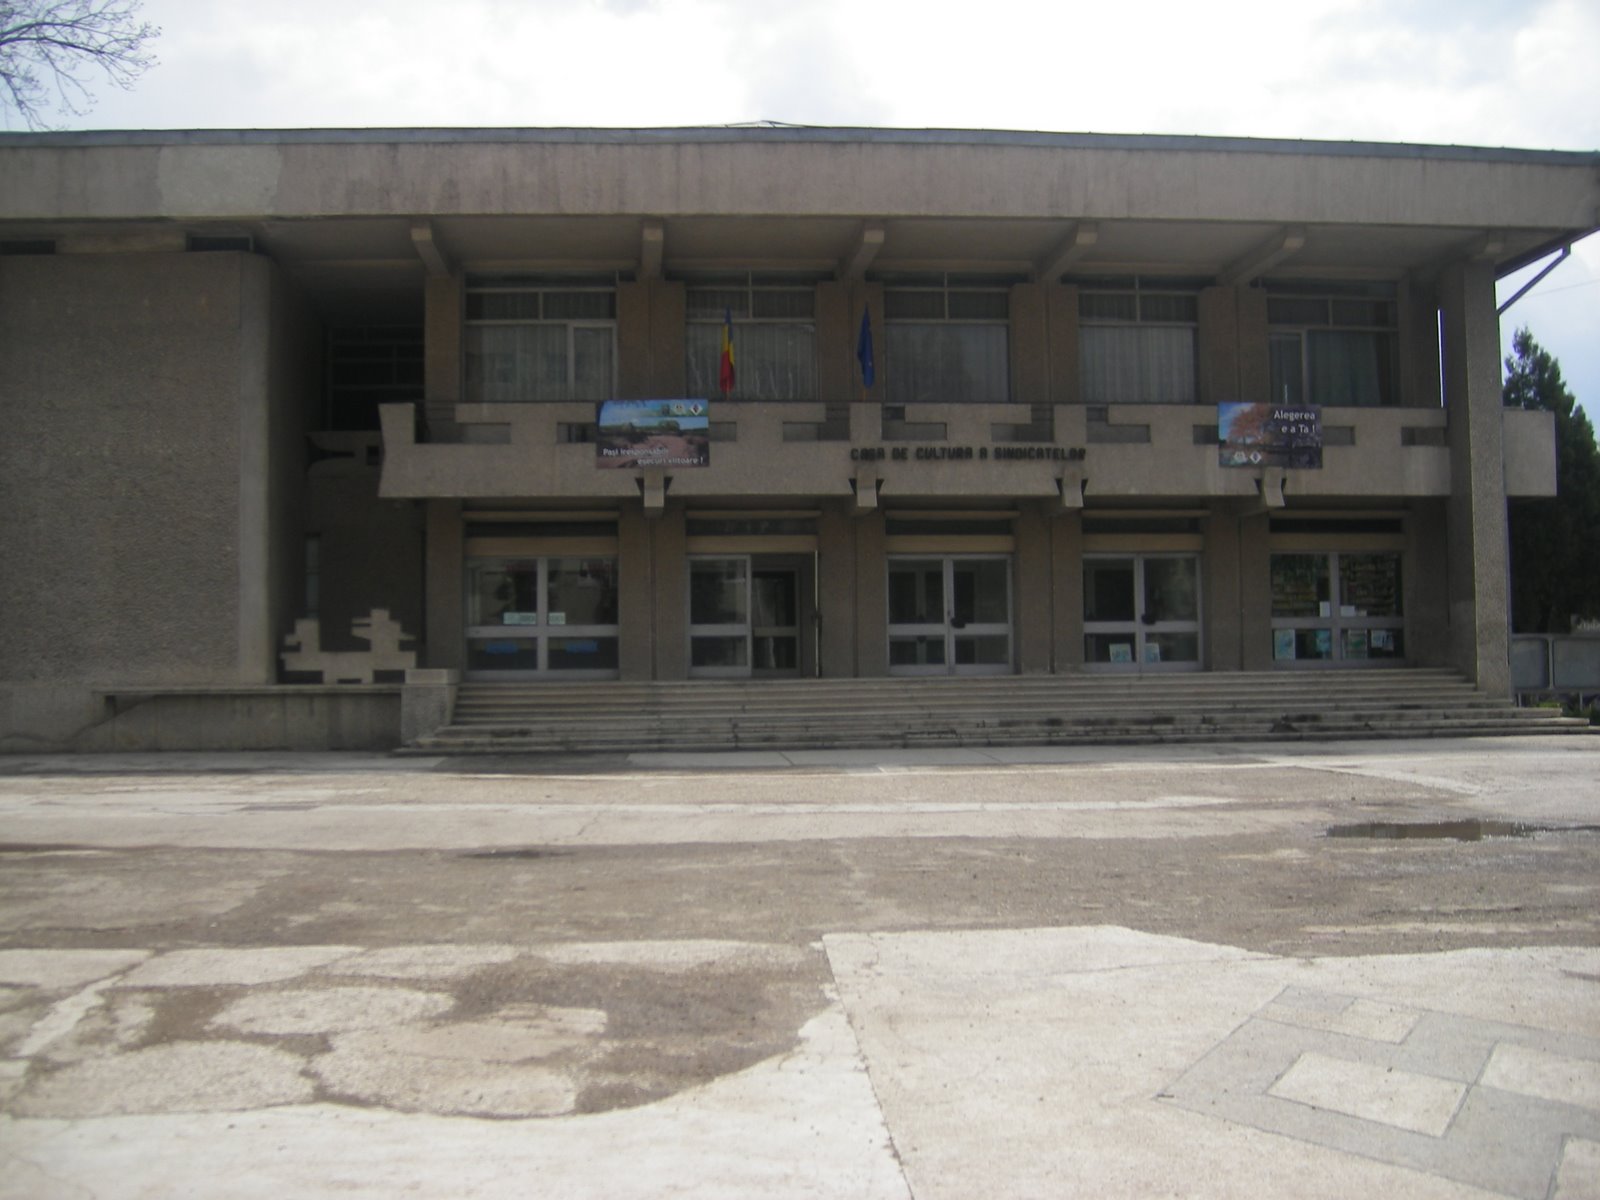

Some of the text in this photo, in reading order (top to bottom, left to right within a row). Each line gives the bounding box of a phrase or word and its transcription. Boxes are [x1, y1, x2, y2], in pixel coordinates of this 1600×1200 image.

[1274, 410, 1315, 422] Alegerea
[850, 447, 1086, 460] CASA DE CULTURA A SINDICATELOR
